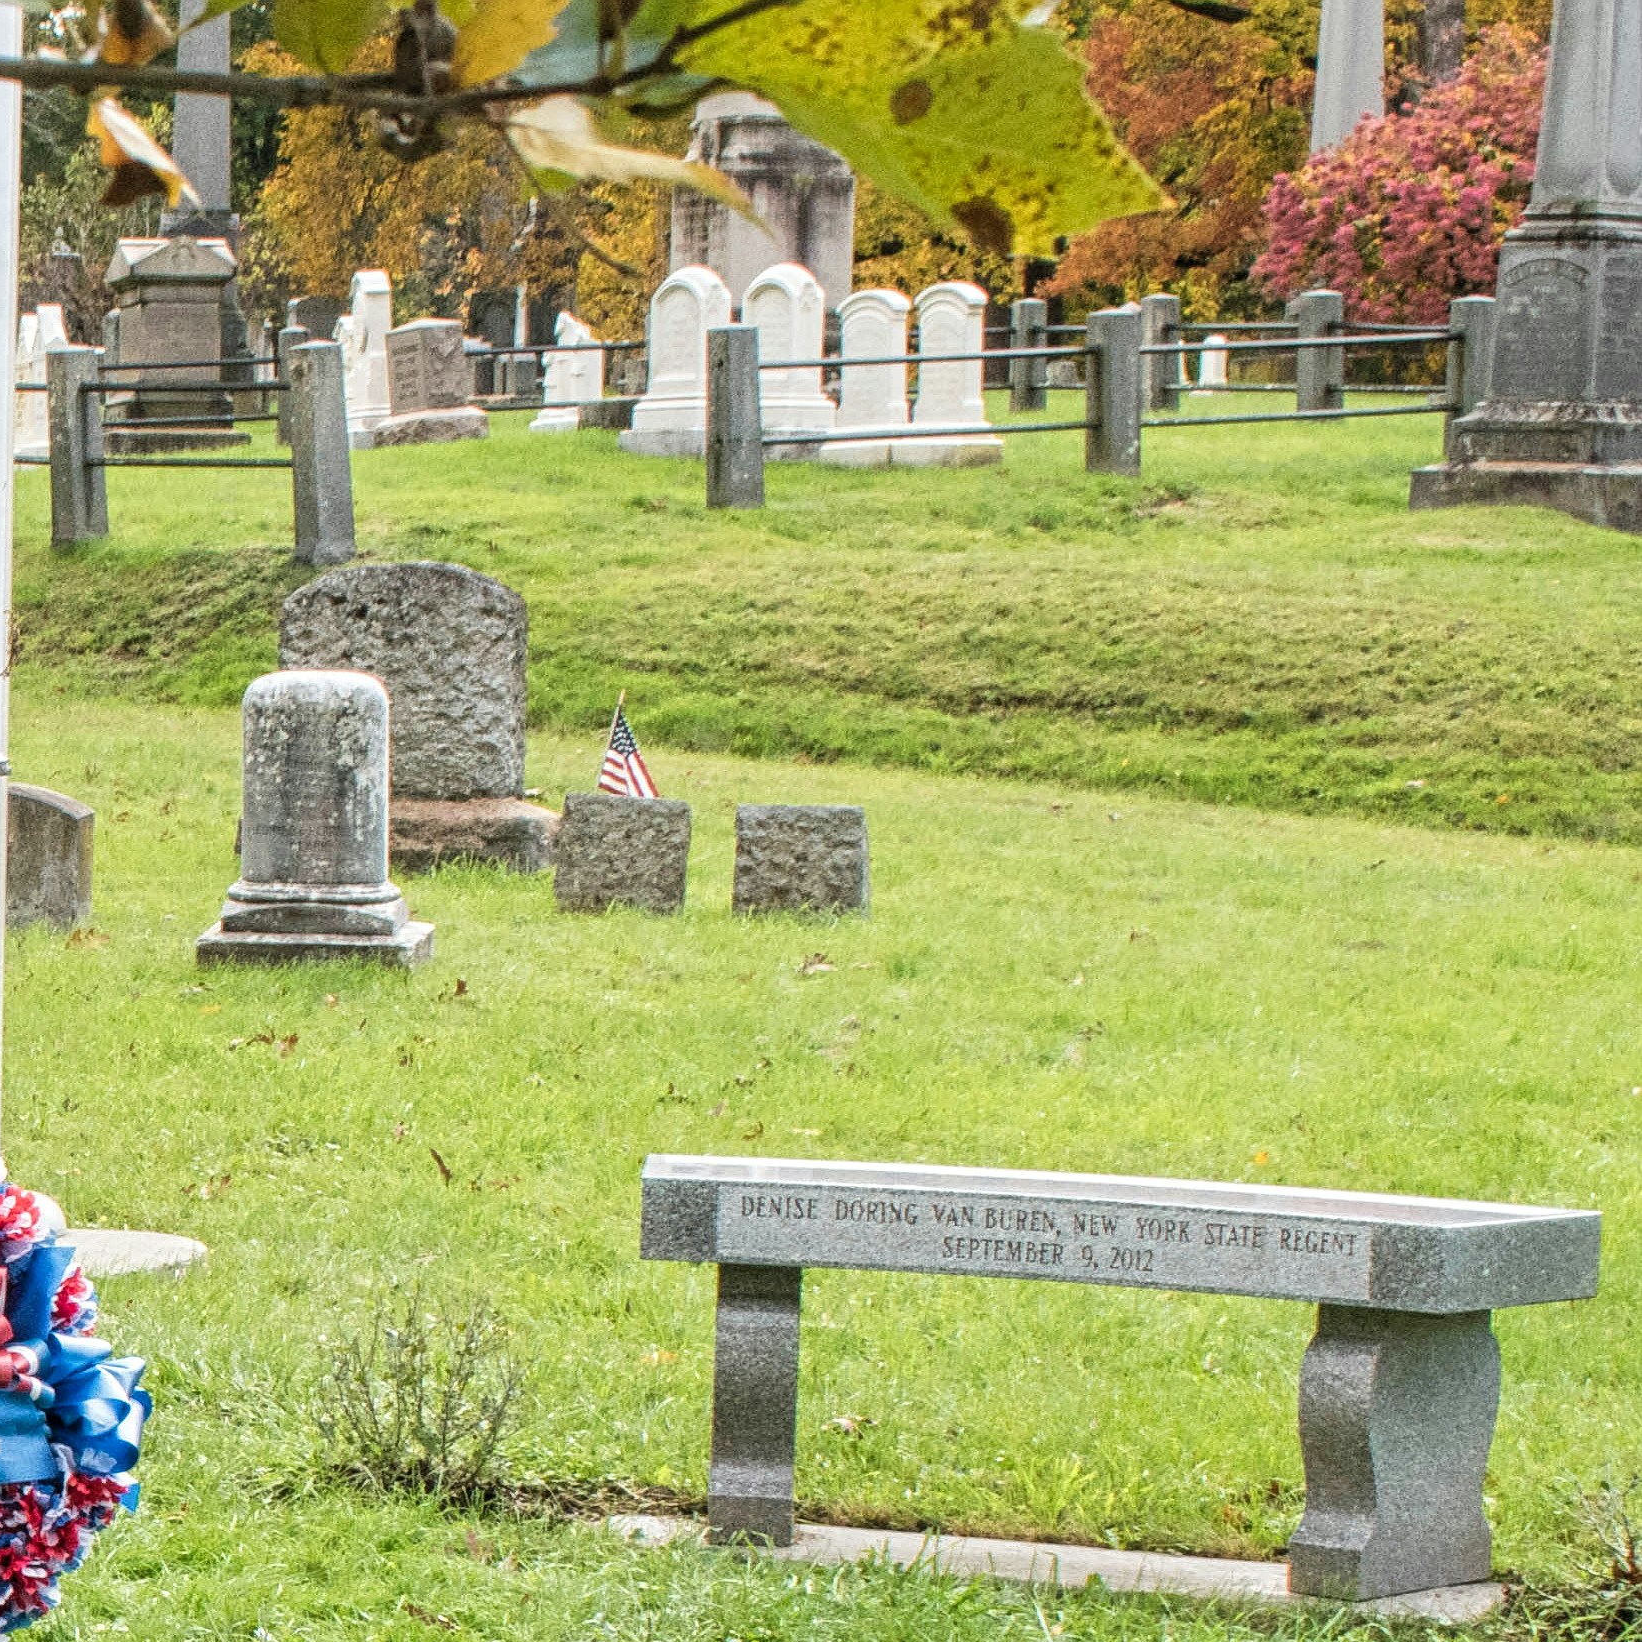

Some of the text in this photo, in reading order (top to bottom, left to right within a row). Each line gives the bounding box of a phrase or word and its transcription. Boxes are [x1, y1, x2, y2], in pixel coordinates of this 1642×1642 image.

[740, 1195, 1359, 1257] DENISE DORING VAN BUREN, NEW YORK STATE REGENT
[941, 1235, 1155, 1273] SEPTEMBER 9, 2012
